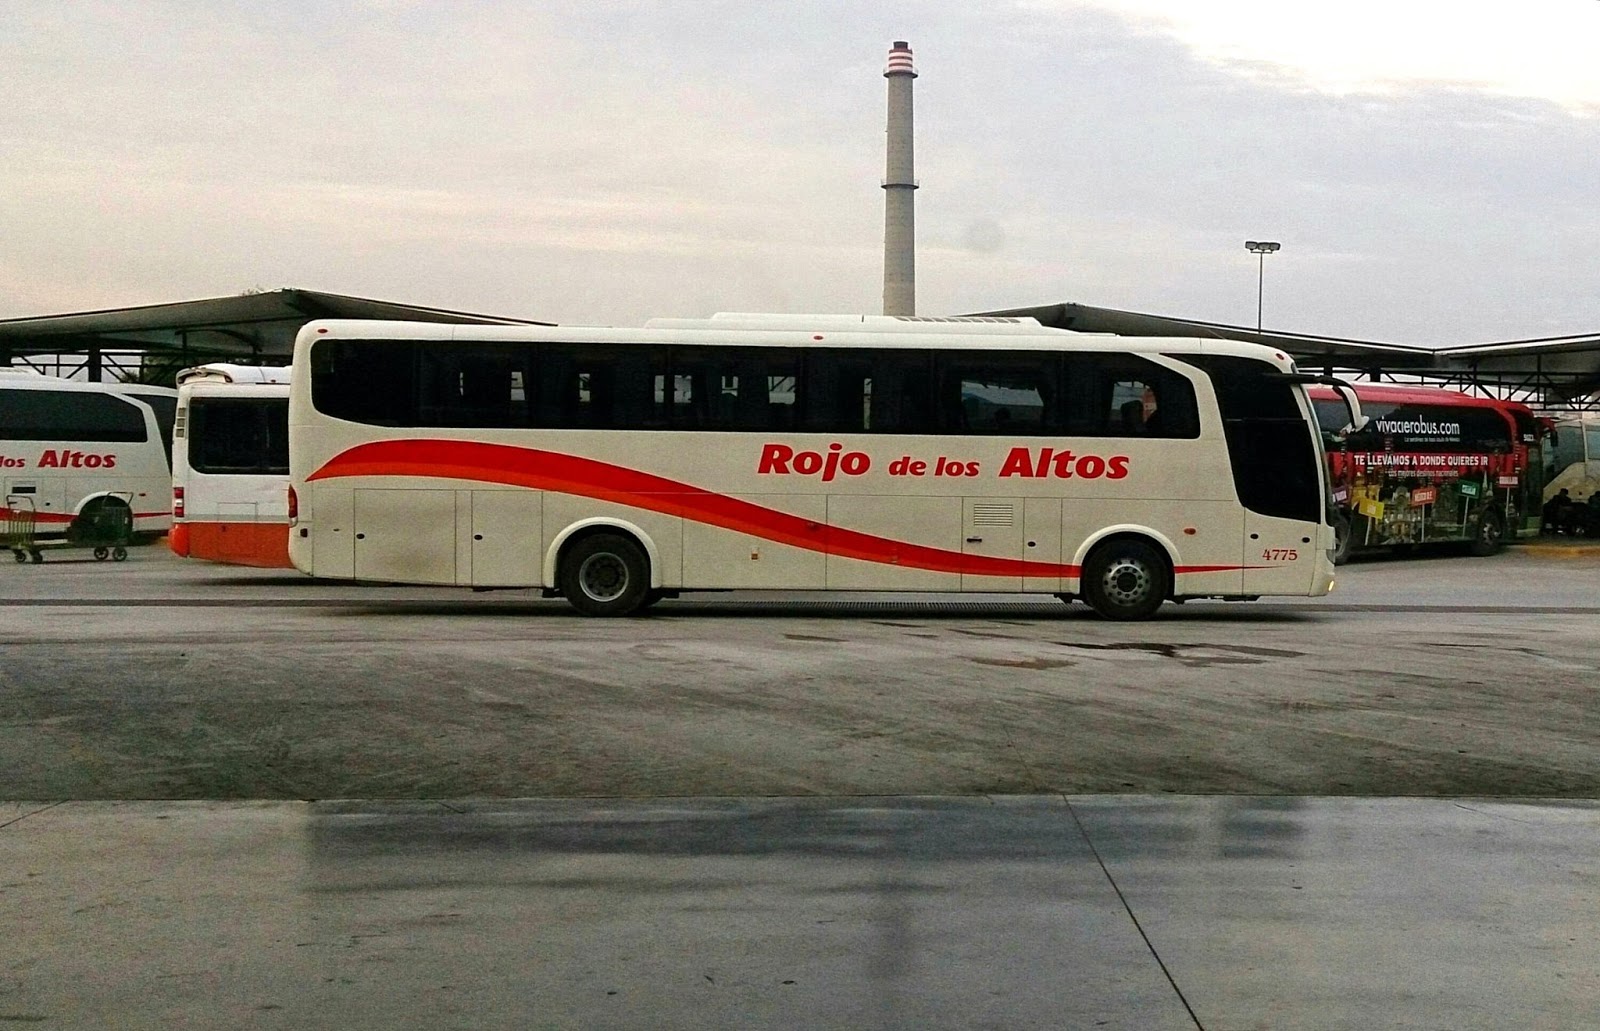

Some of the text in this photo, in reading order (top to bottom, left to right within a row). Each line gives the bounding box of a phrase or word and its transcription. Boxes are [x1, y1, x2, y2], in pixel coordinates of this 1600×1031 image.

[38, 449, 117, 469] Altos
[758, 443, 1130, 481] Rojo de los Altos
[1354, 454, 1489, 467] TE LLEVAMOS A DONDE QUIERES IR
[1262, 549, 1298, 561] 4775
